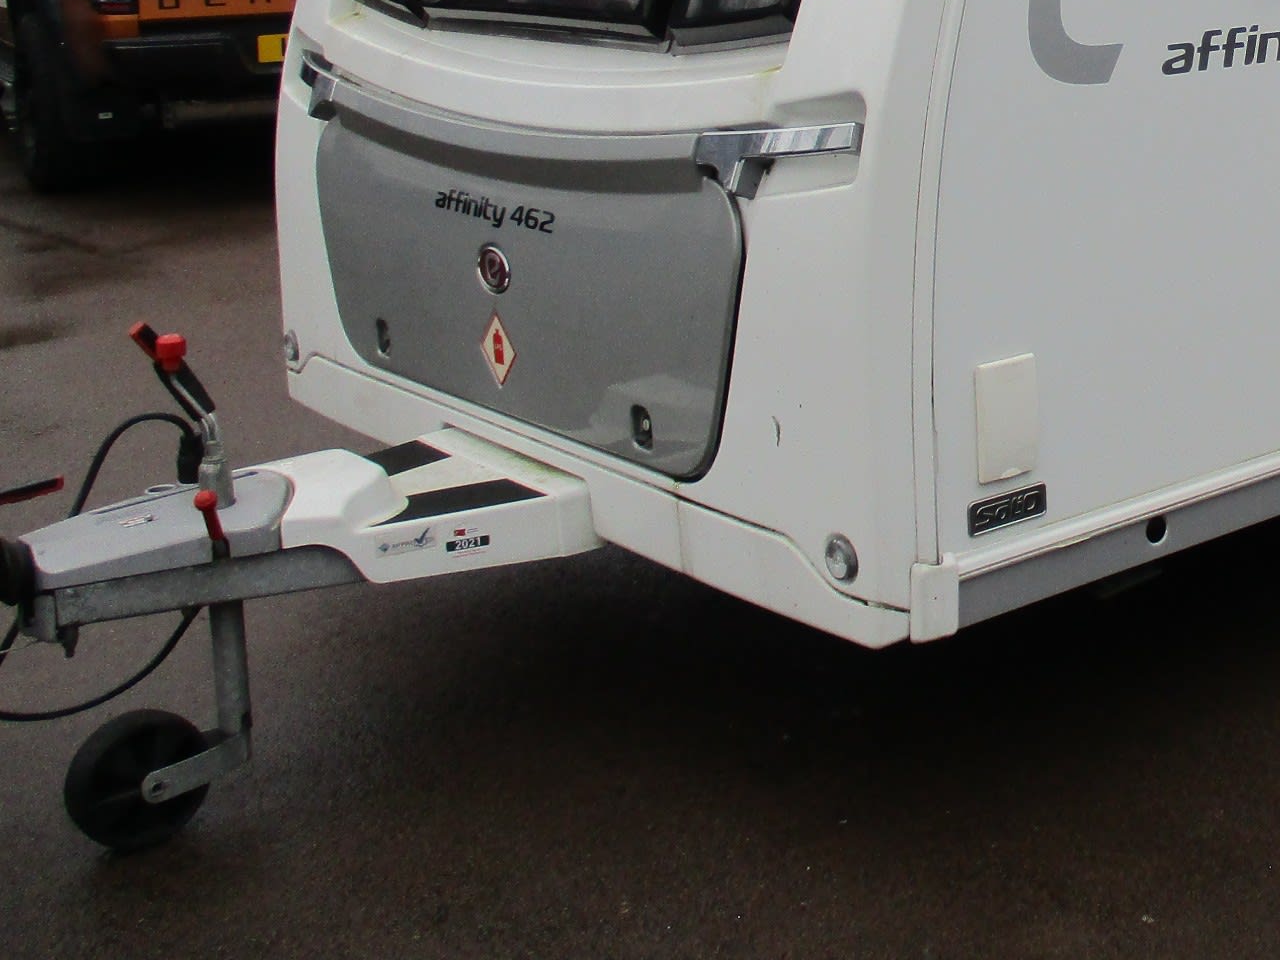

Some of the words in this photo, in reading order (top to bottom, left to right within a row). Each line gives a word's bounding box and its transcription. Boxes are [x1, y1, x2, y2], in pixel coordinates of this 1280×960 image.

[435, 189, 506, 229] affinity
[510, 205, 556, 234] 462
[455, 537, 482, 550] 2021
